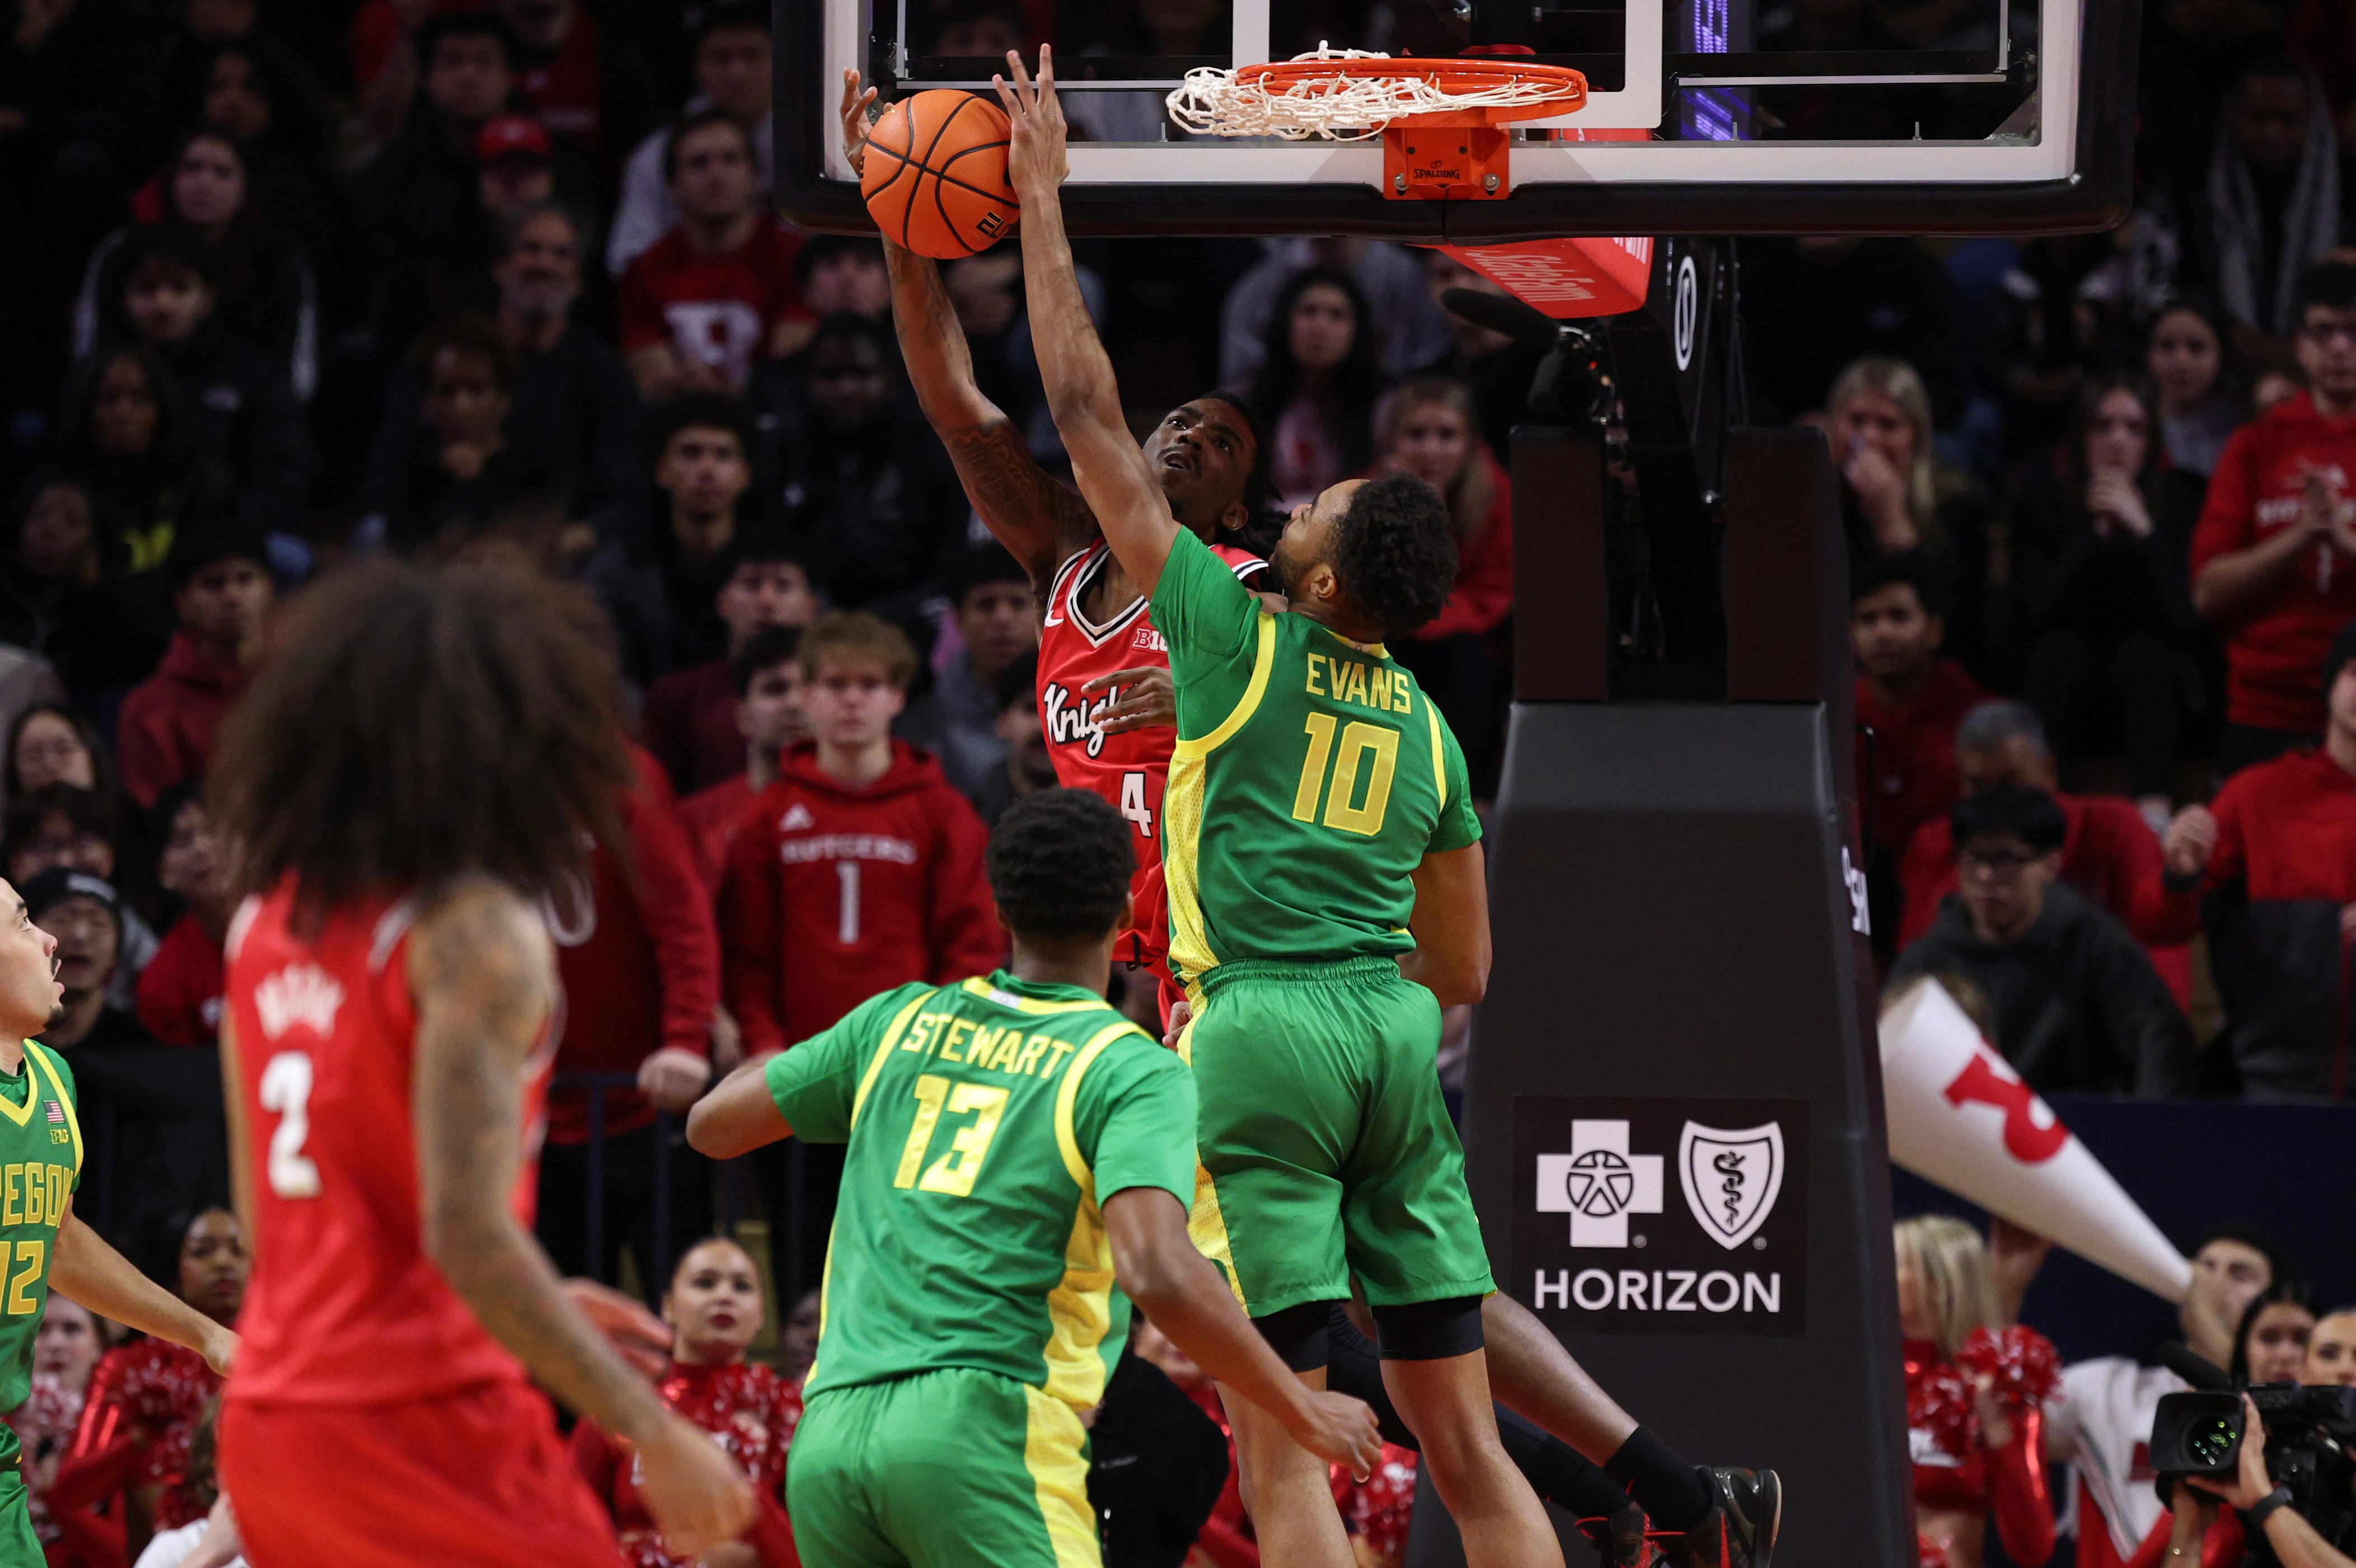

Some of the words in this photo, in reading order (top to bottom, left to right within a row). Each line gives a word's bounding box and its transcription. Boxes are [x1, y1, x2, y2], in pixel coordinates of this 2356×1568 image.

[1414, 168, 1460, 179] SPALDING
[1306, 652, 1412, 715] EVANS
[1043, 681, 1147, 760] Knig
[1121, 771, 1153, 838] 4
[1292, 711, 1401, 837] 10
[836, 860, 860, 945] 1
[900, 1012, 1076, 1080] STEWART
[259, 1049, 322, 1199] 2
[893, 1073, 1011, 1198] 13
[0, 1162, 73, 1229] EGON
[1534, 1268, 1781, 1313] HORIZON
